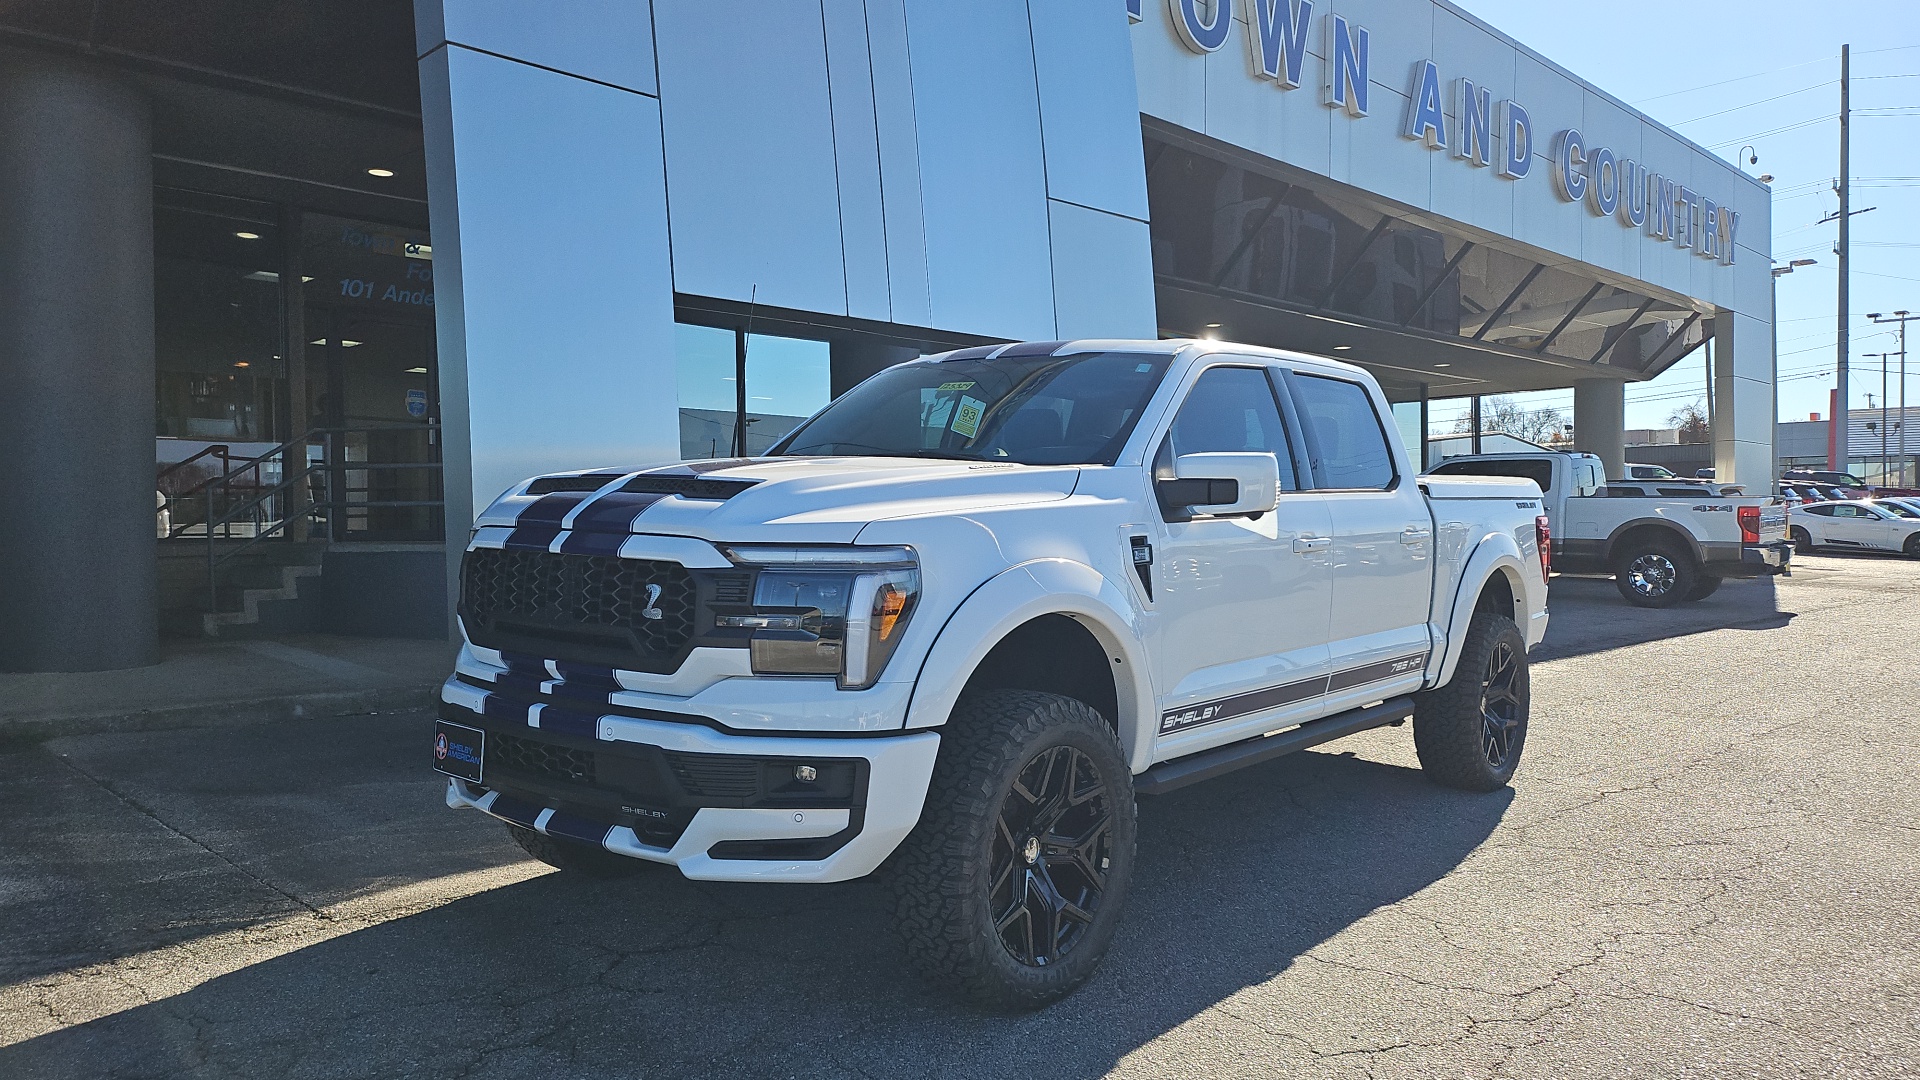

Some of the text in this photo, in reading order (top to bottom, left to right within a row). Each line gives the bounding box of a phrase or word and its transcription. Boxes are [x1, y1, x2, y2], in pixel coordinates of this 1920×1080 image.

[1127, 0, 1742, 266] OWN AND COUNTRY
[340, 278, 375, 299] 101
[962, 408, 977, 421] 93
[1162, 704, 1223, 729] SHELBY
[449, 742, 474, 755] SHELBY
[447, 750, 481, 765] AMERICAN
[621, 805, 668, 819] SHELBY
